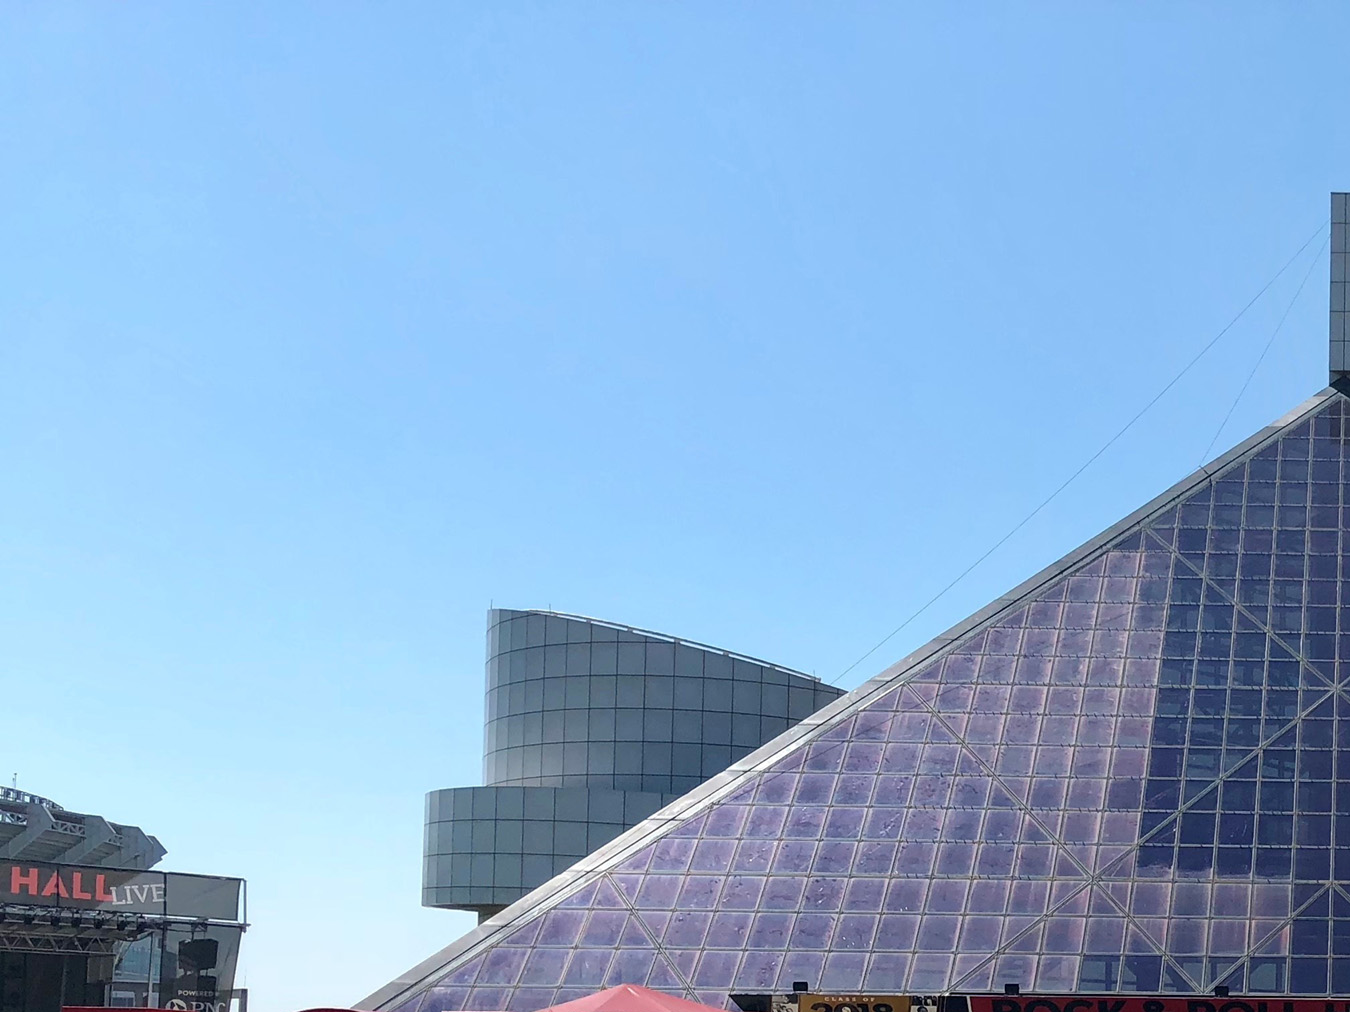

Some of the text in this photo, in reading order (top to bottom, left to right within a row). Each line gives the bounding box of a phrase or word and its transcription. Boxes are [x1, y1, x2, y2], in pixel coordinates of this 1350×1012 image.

[10, 866, 165, 905] HALL LIVE
[177, 989, 213, 997] POWERED
